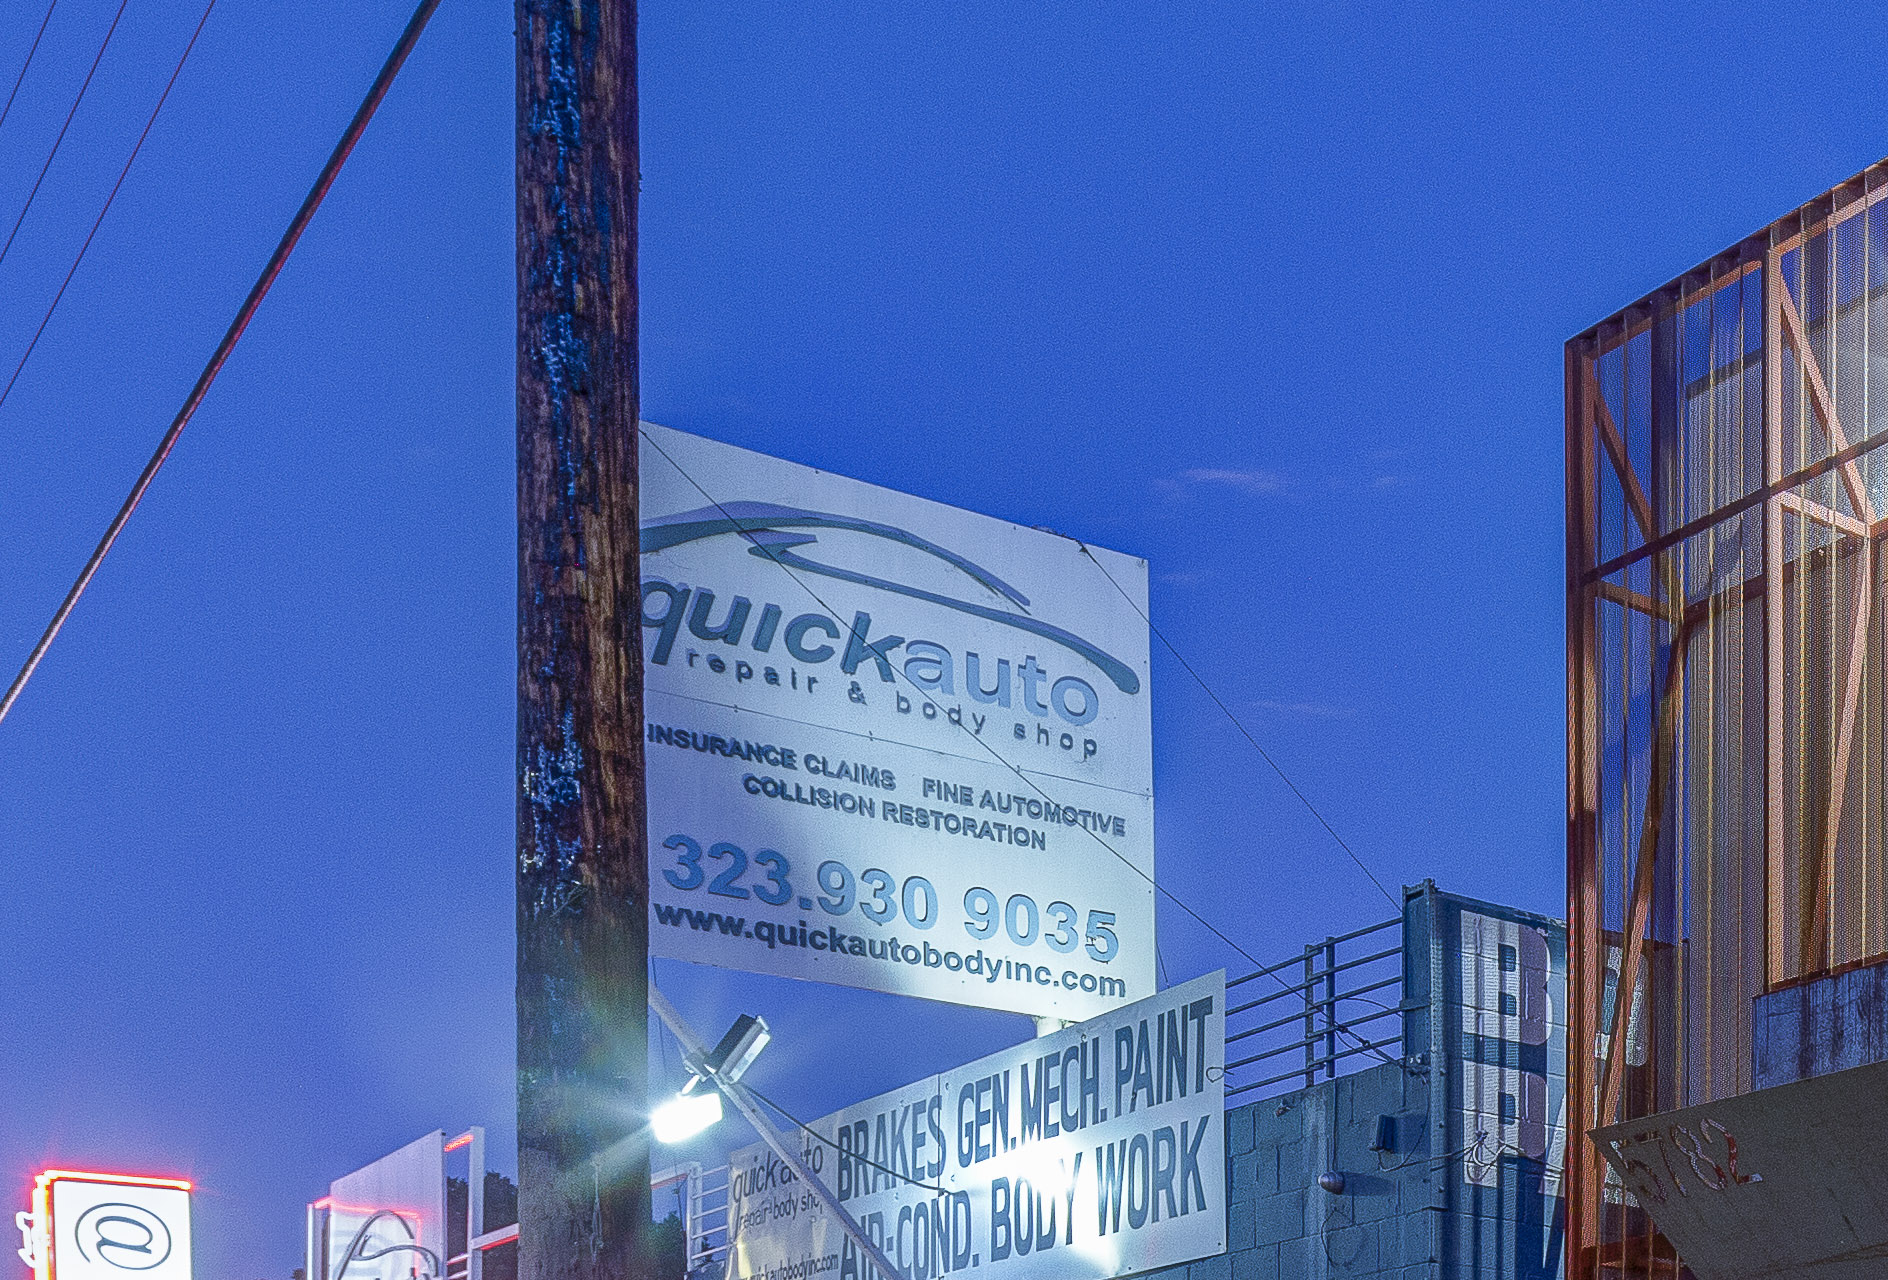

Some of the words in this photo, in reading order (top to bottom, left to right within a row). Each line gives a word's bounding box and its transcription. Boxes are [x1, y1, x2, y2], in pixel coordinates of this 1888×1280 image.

[640, 576, 1100, 726] quickauto
[688, 647, 818, 694] repair
[847, 681, 867, 705] &
[896, 688, 988, 734] body
[1014, 721, 1099, 759] shop
[647, 723, 797, 770] INSURANCE
[804, 752, 897, 791] CLAIMS
[923, 776, 975, 806] FINE
[980, 789, 1127, 838] AUTOMOTIVE
[742, 772, 876, 819] COLLISION
[882, 799, 1047, 851] RESTORATION
[653, 900, 1127, 999] www.quickautobodyinc.com
[963, 886, 1121, 965] 9035
[838, 1094, 947, 1202] BRAKES
[957, 1067, 1017, 1168] GEN.
[1114, 996, 1214, 1118] PAINT
[990, 1151, 1083, 1262] BODY
[1095, 1114, 1211, 1237] WORK
